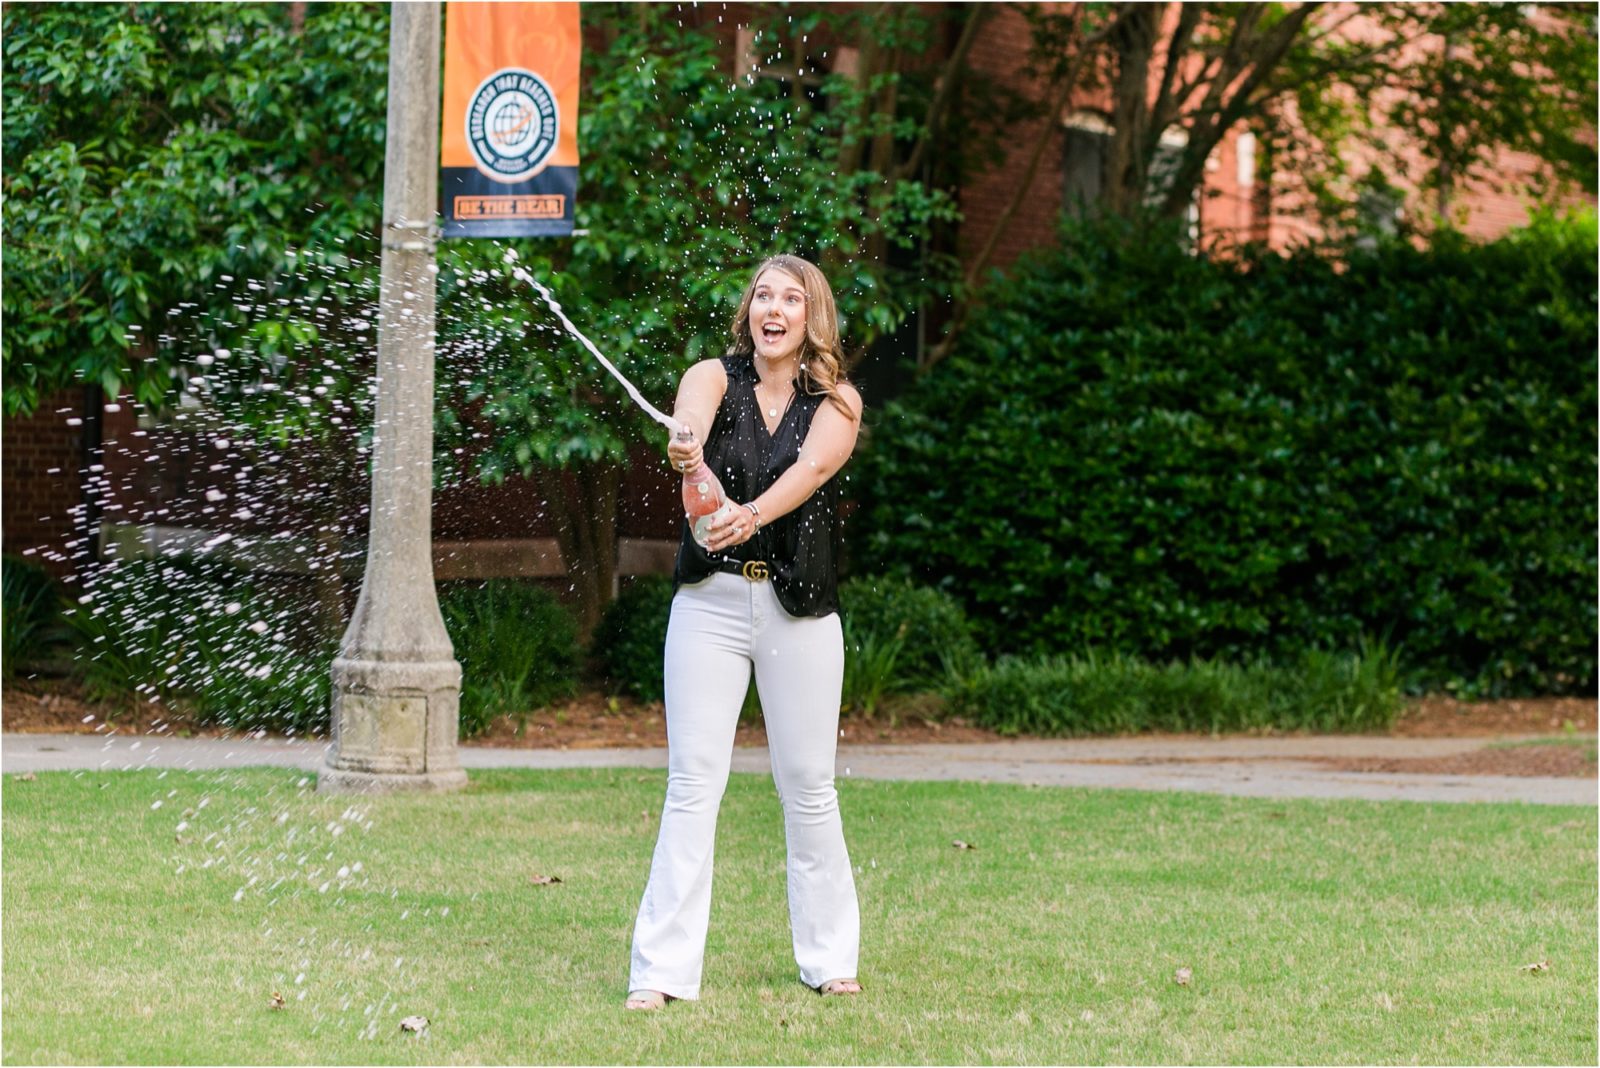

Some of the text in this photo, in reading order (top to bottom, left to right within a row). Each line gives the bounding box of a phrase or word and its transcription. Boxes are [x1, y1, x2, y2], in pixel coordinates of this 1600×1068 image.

[495, 75, 519, 92] THAT
[459, 199, 560, 214] BE THE BEAR
